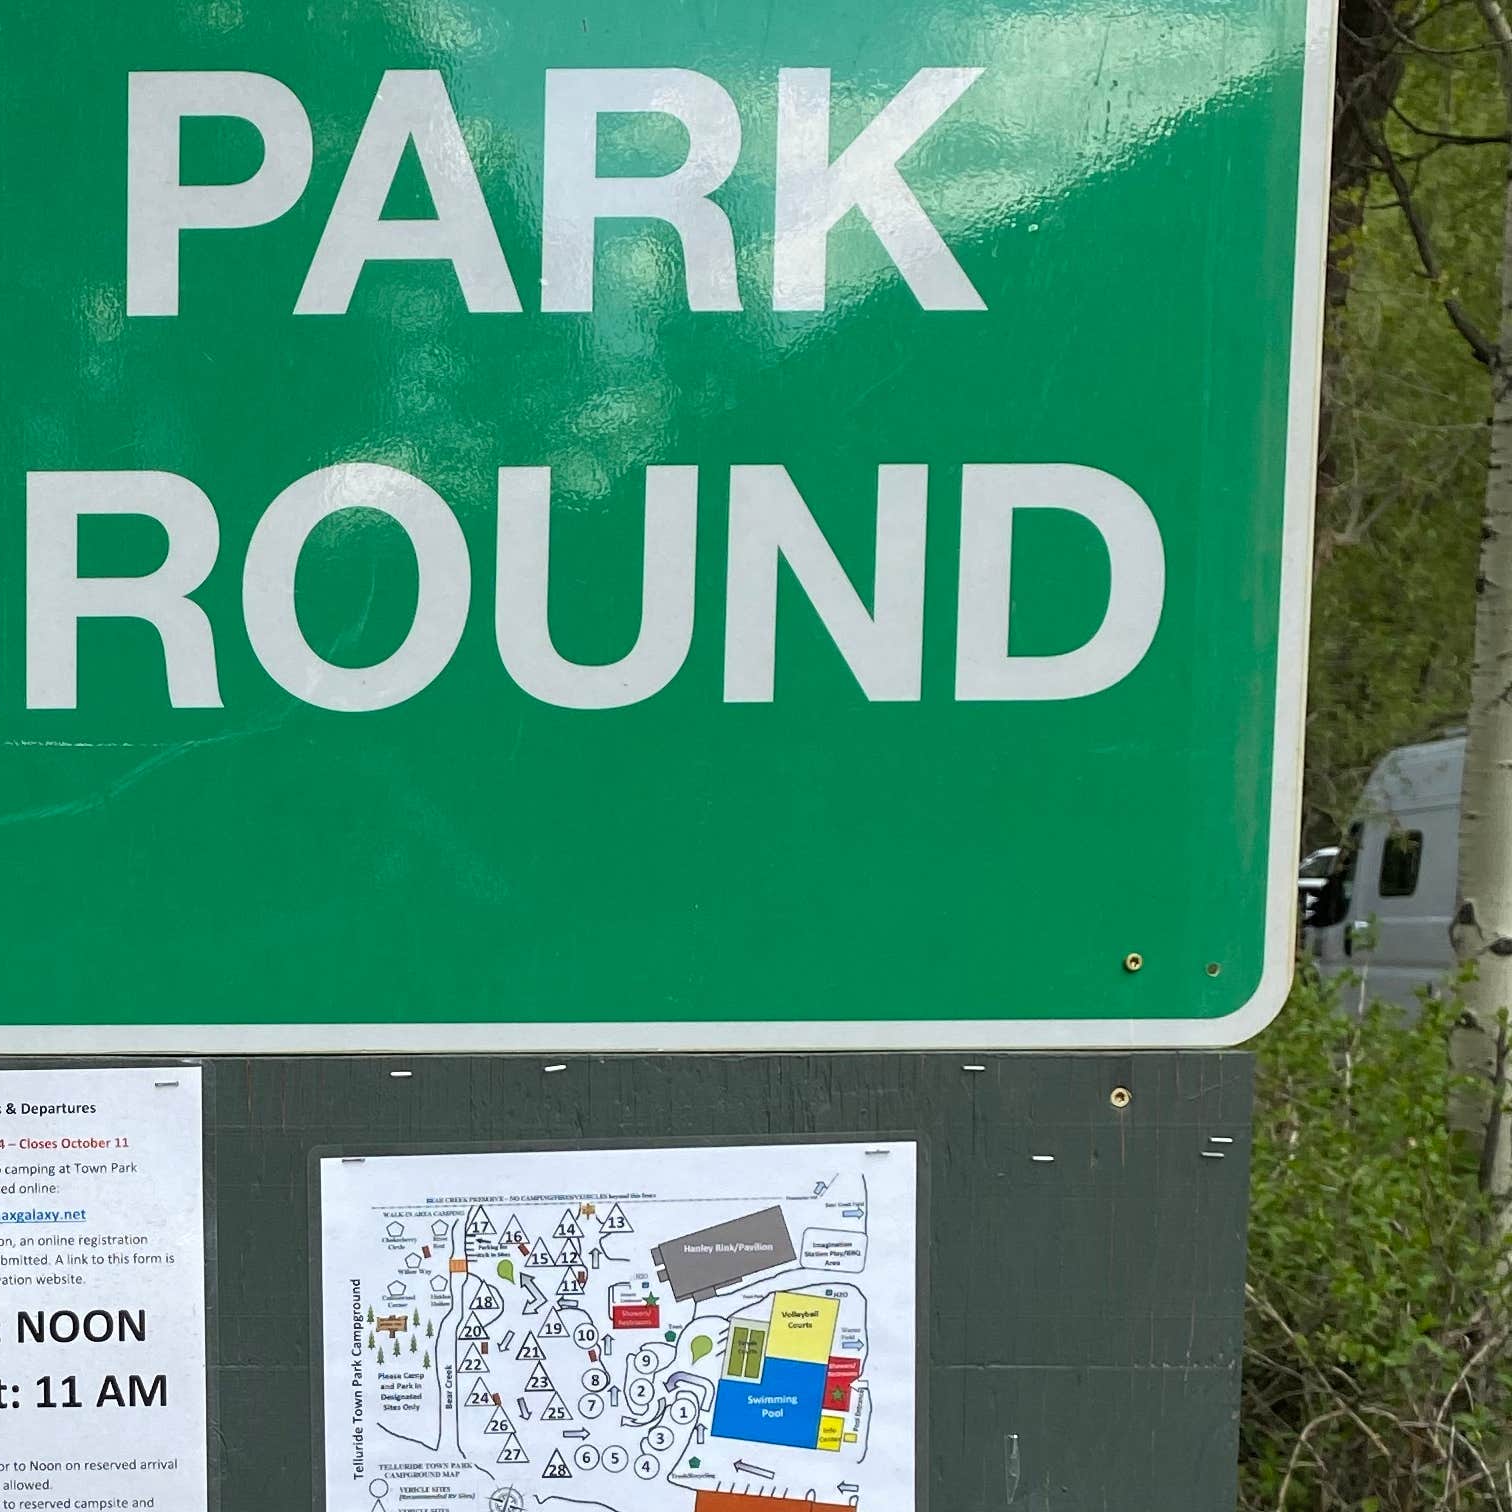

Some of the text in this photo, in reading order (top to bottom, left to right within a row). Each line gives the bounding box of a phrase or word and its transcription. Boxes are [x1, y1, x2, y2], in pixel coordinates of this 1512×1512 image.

[126, 65, 989, 317] PARK
[5, 1102, 17, 1115] &
[21, 1103, 97, 1117] Departures
[19, 1137, 58, 1150] Closes
[61, 1137, 111, 1149] October
[115, 1137, 129, 1148] 11
[4, 1164, 56, 1177] camping
[58, 1164, 71, 1174] at
[73, 1162, 107, 1174] Town
[111, 1162, 137, 1173] Park
[608, 1217, 625, 1229] 13
[505, 1231, 522, 1243] 16
[683, 1243, 714, 1255] Hanley
[18, 1310, 145, 1343] NOON
[577, 1330, 595, 1341] 10
[350, 1279, 364, 1481] Telluride Town Park Campground
[37, 1376, 82, 1408] 11
[96, 1375, 166, 1407] AM
[444, 1364, 453, 1410] Bear Creek
[637, 1386, 645, 1397] 2
[748, 1395, 798, 1406] Swimming
[680, 1406, 688, 1418] 1
[761, 1407, 784, 1418] Pool
[657, 1433, 665, 1445] 3
[504, 1449, 521, 1460] 27
[582, 1452, 591, 1464] 6
[611, 1453, 619, 1465] 5
[549, 1465, 566, 1477] 28
[641, 1461, 650, 1472] 4
